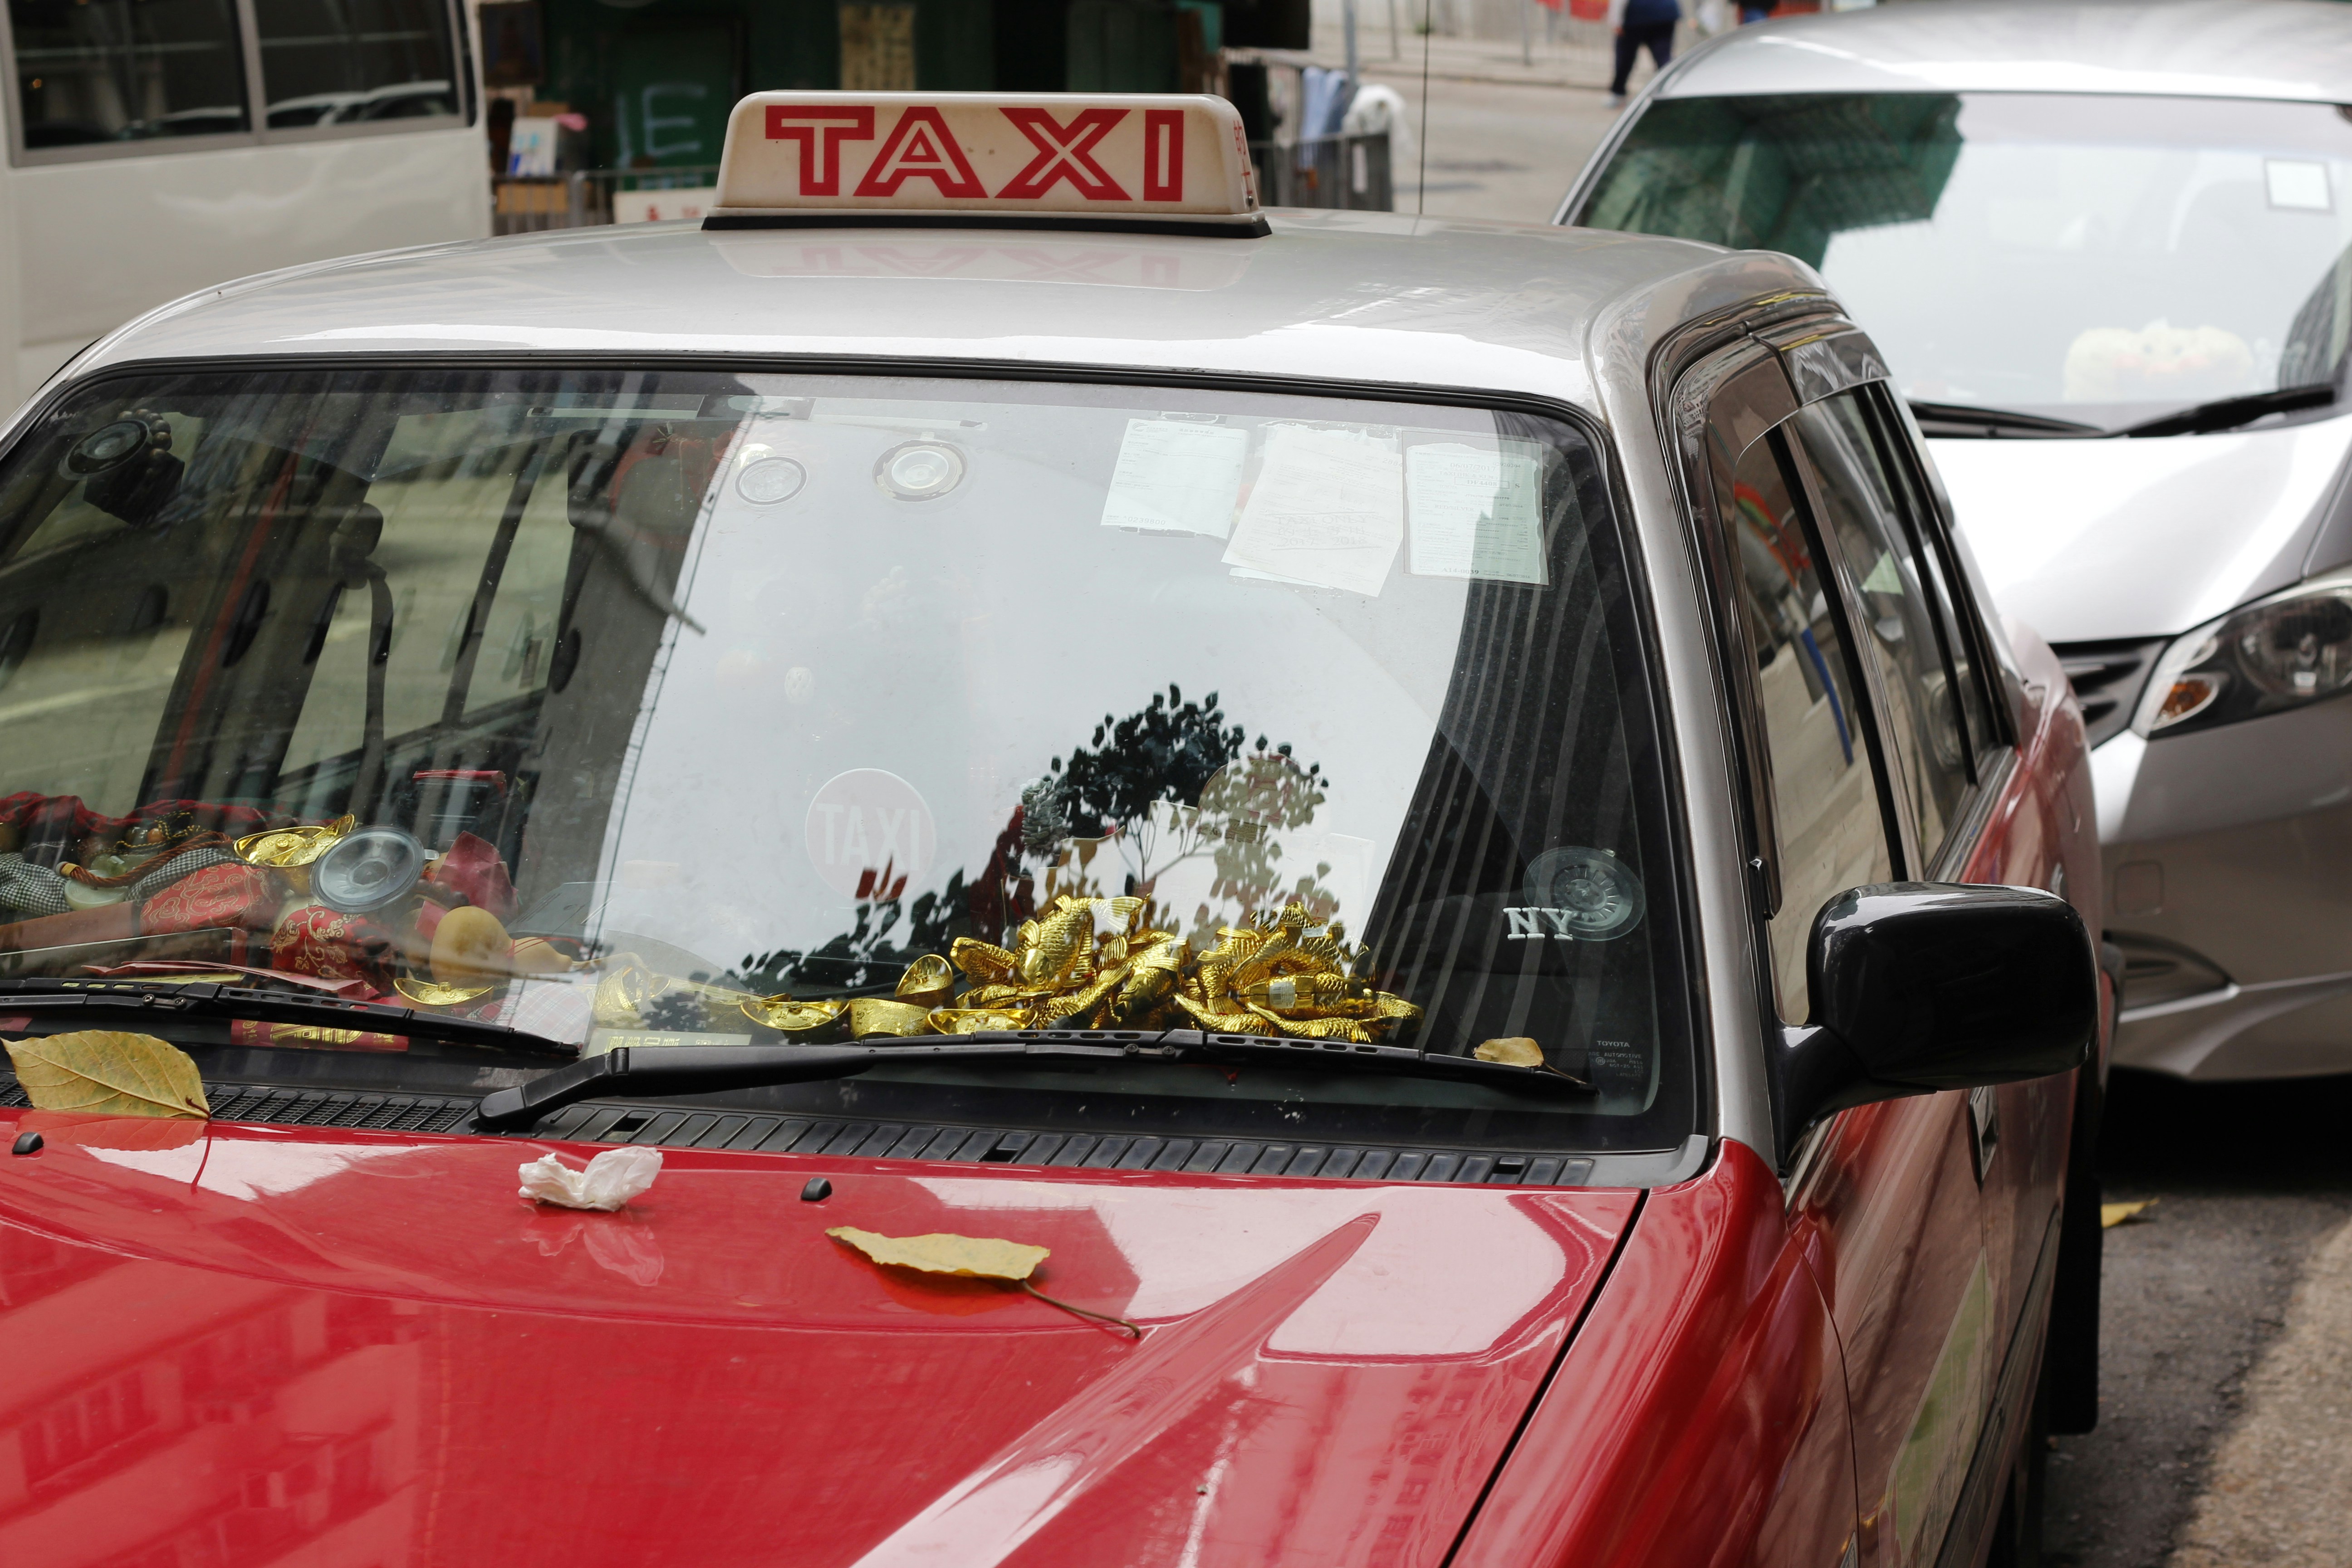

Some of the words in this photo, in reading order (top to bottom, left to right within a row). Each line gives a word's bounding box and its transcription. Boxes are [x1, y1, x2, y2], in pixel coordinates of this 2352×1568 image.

[765, 105, 1184, 202] TAXI
[1233, 120, 1254, 195] 的士
[1450, 462, 1496, 472] 06/07/2017
[1466, 479, 1498, 487] DF4408
[1127, 516, 1166, 525] 0239800
[1322, 514, 1368, 524] ONLY
[1441, 567, 1480, 575] A14-0039
[816, 803, 921, 871] TAXI
[1502, 906, 1573, 941] NY
